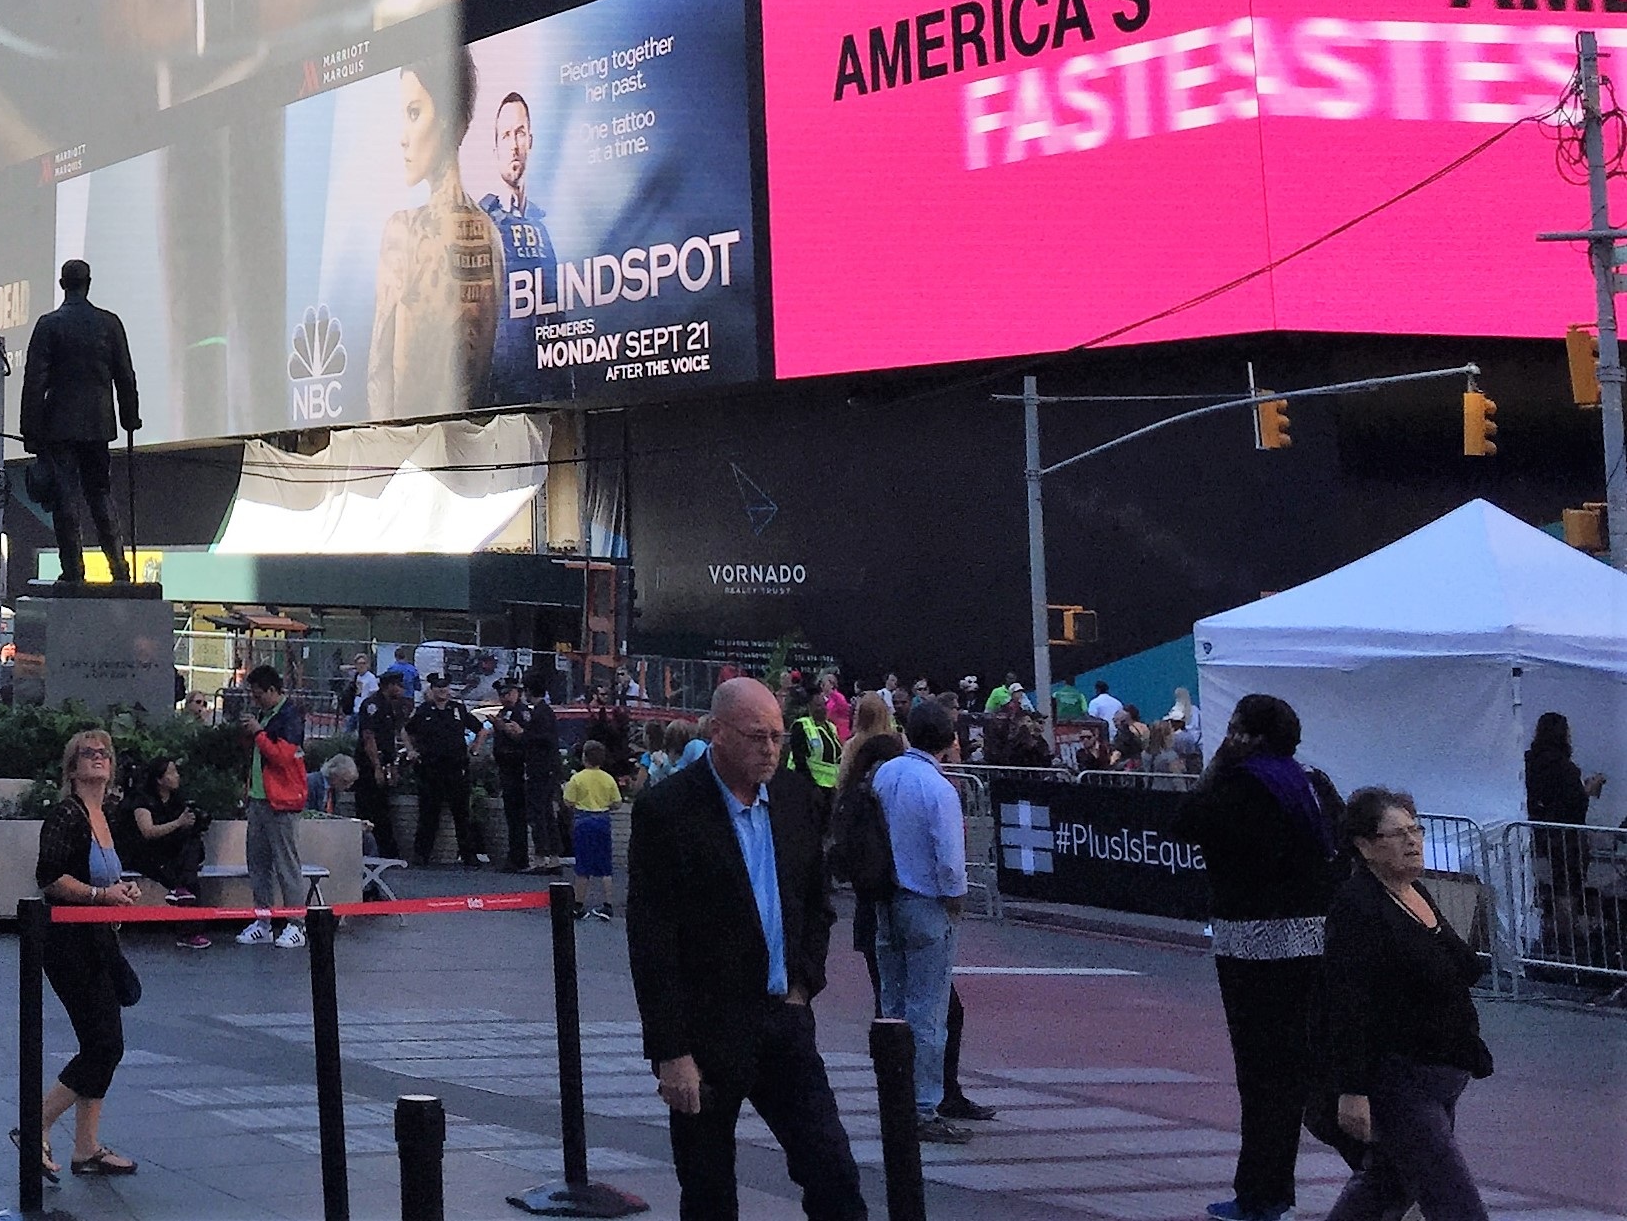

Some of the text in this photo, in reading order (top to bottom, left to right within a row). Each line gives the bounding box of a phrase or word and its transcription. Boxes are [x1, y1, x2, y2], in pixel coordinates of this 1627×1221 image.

[322, 40, 370, 68] MARRIOTT
[559, 35, 674, 86] Piecing together
[323, 58, 365, 83] MARQUIS
[585, 71, 647, 105] her past.
[578, 108, 655, 144] One tattoo
[587, 134, 649, 165] at a time.
[510, 224, 544, 248] FBI
[509, 230, 741, 321] BLINDSPOT
[535, 319, 595, 341] PREMIERES
[537, 321, 710, 369] MONDAY SEPT 21
[606, 355, 710, 381] AFTER THE VOICE
[293, 382, 342, 421] NBC
[708, 564, 806, 584] VORNADO
